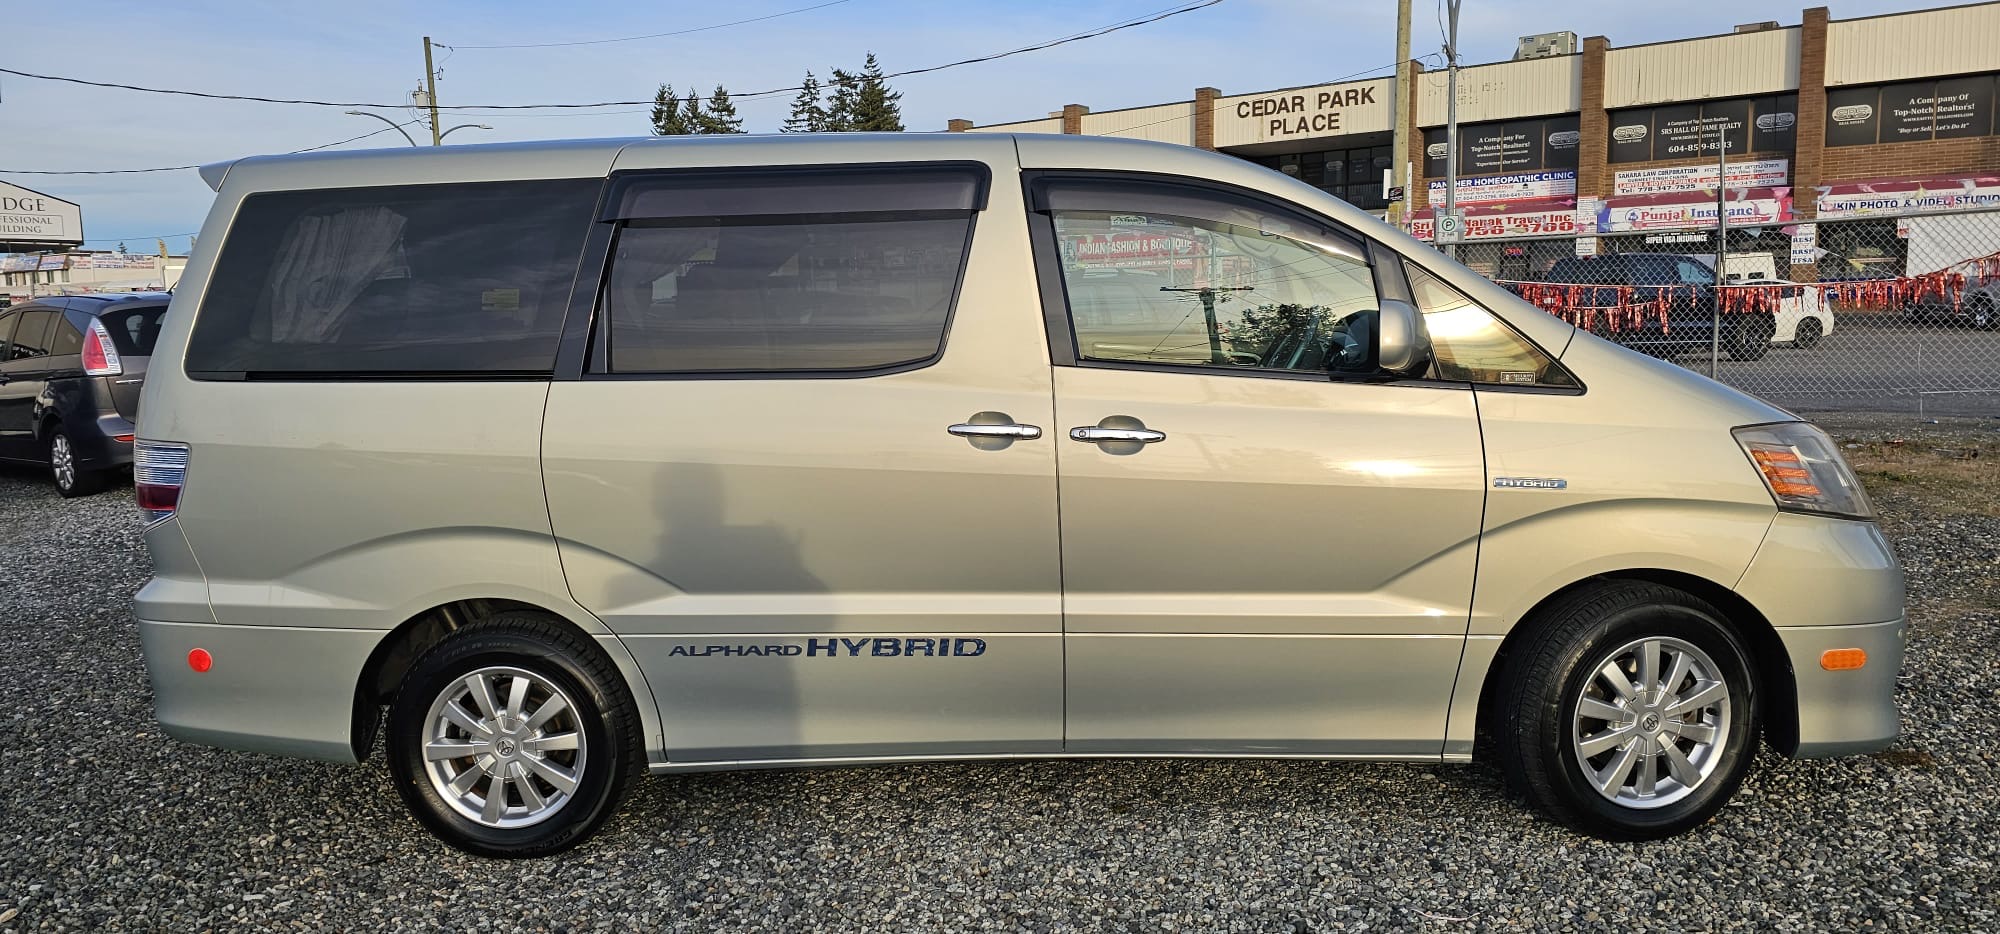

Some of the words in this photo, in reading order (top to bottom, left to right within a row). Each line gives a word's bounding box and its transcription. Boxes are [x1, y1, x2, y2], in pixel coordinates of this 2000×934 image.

[1237, 96, 1305, 118] CEDAR
[1318, 86, 1375, 109] PARK
[1959, 93, 1970, 101] Of
[1893, 107, 1934, 117] Top-Notch
[1937, 103, 1975, 113] Realtors!
[1270, 113, 1340, 136] PLACE
[1702, 124, 1718, 132] FAME
[1719, 122, 1742, 130] REALTY
[1430, 179, 1473, 189] PANHER
[1474, 175, 1540, 186] HOMEOPATHIC
[1543, 171, 1574, 181] CLINIC
[3, 197, 46, 212] DGE
[1860, 199, 1898, 209] PHOTO
[1904, 199, 1912, 207] &
[0, 215, 53, 225] ESSIONAL
[1640, 208, 1688, 223] Punja
[1691, 205, 1757, 218] Insuanc
[0, 224, 42, 234] ILDING
[1413, 222, 1430, 230] Sri
[1506, 214, 1547, 225] Travl
[1549, 214, 1575, 223] Inc.
[1142, 239, 1149, 252] &
[1150, 237, 1193, 252] BOIQUE
[1645, 236, 1663, 245] SUPER
[1676, 233, 1708, 243] INSURANCE
[668, 644, 803, 657] ALPHARD
[806, 638, 987, 657] HYBRID
